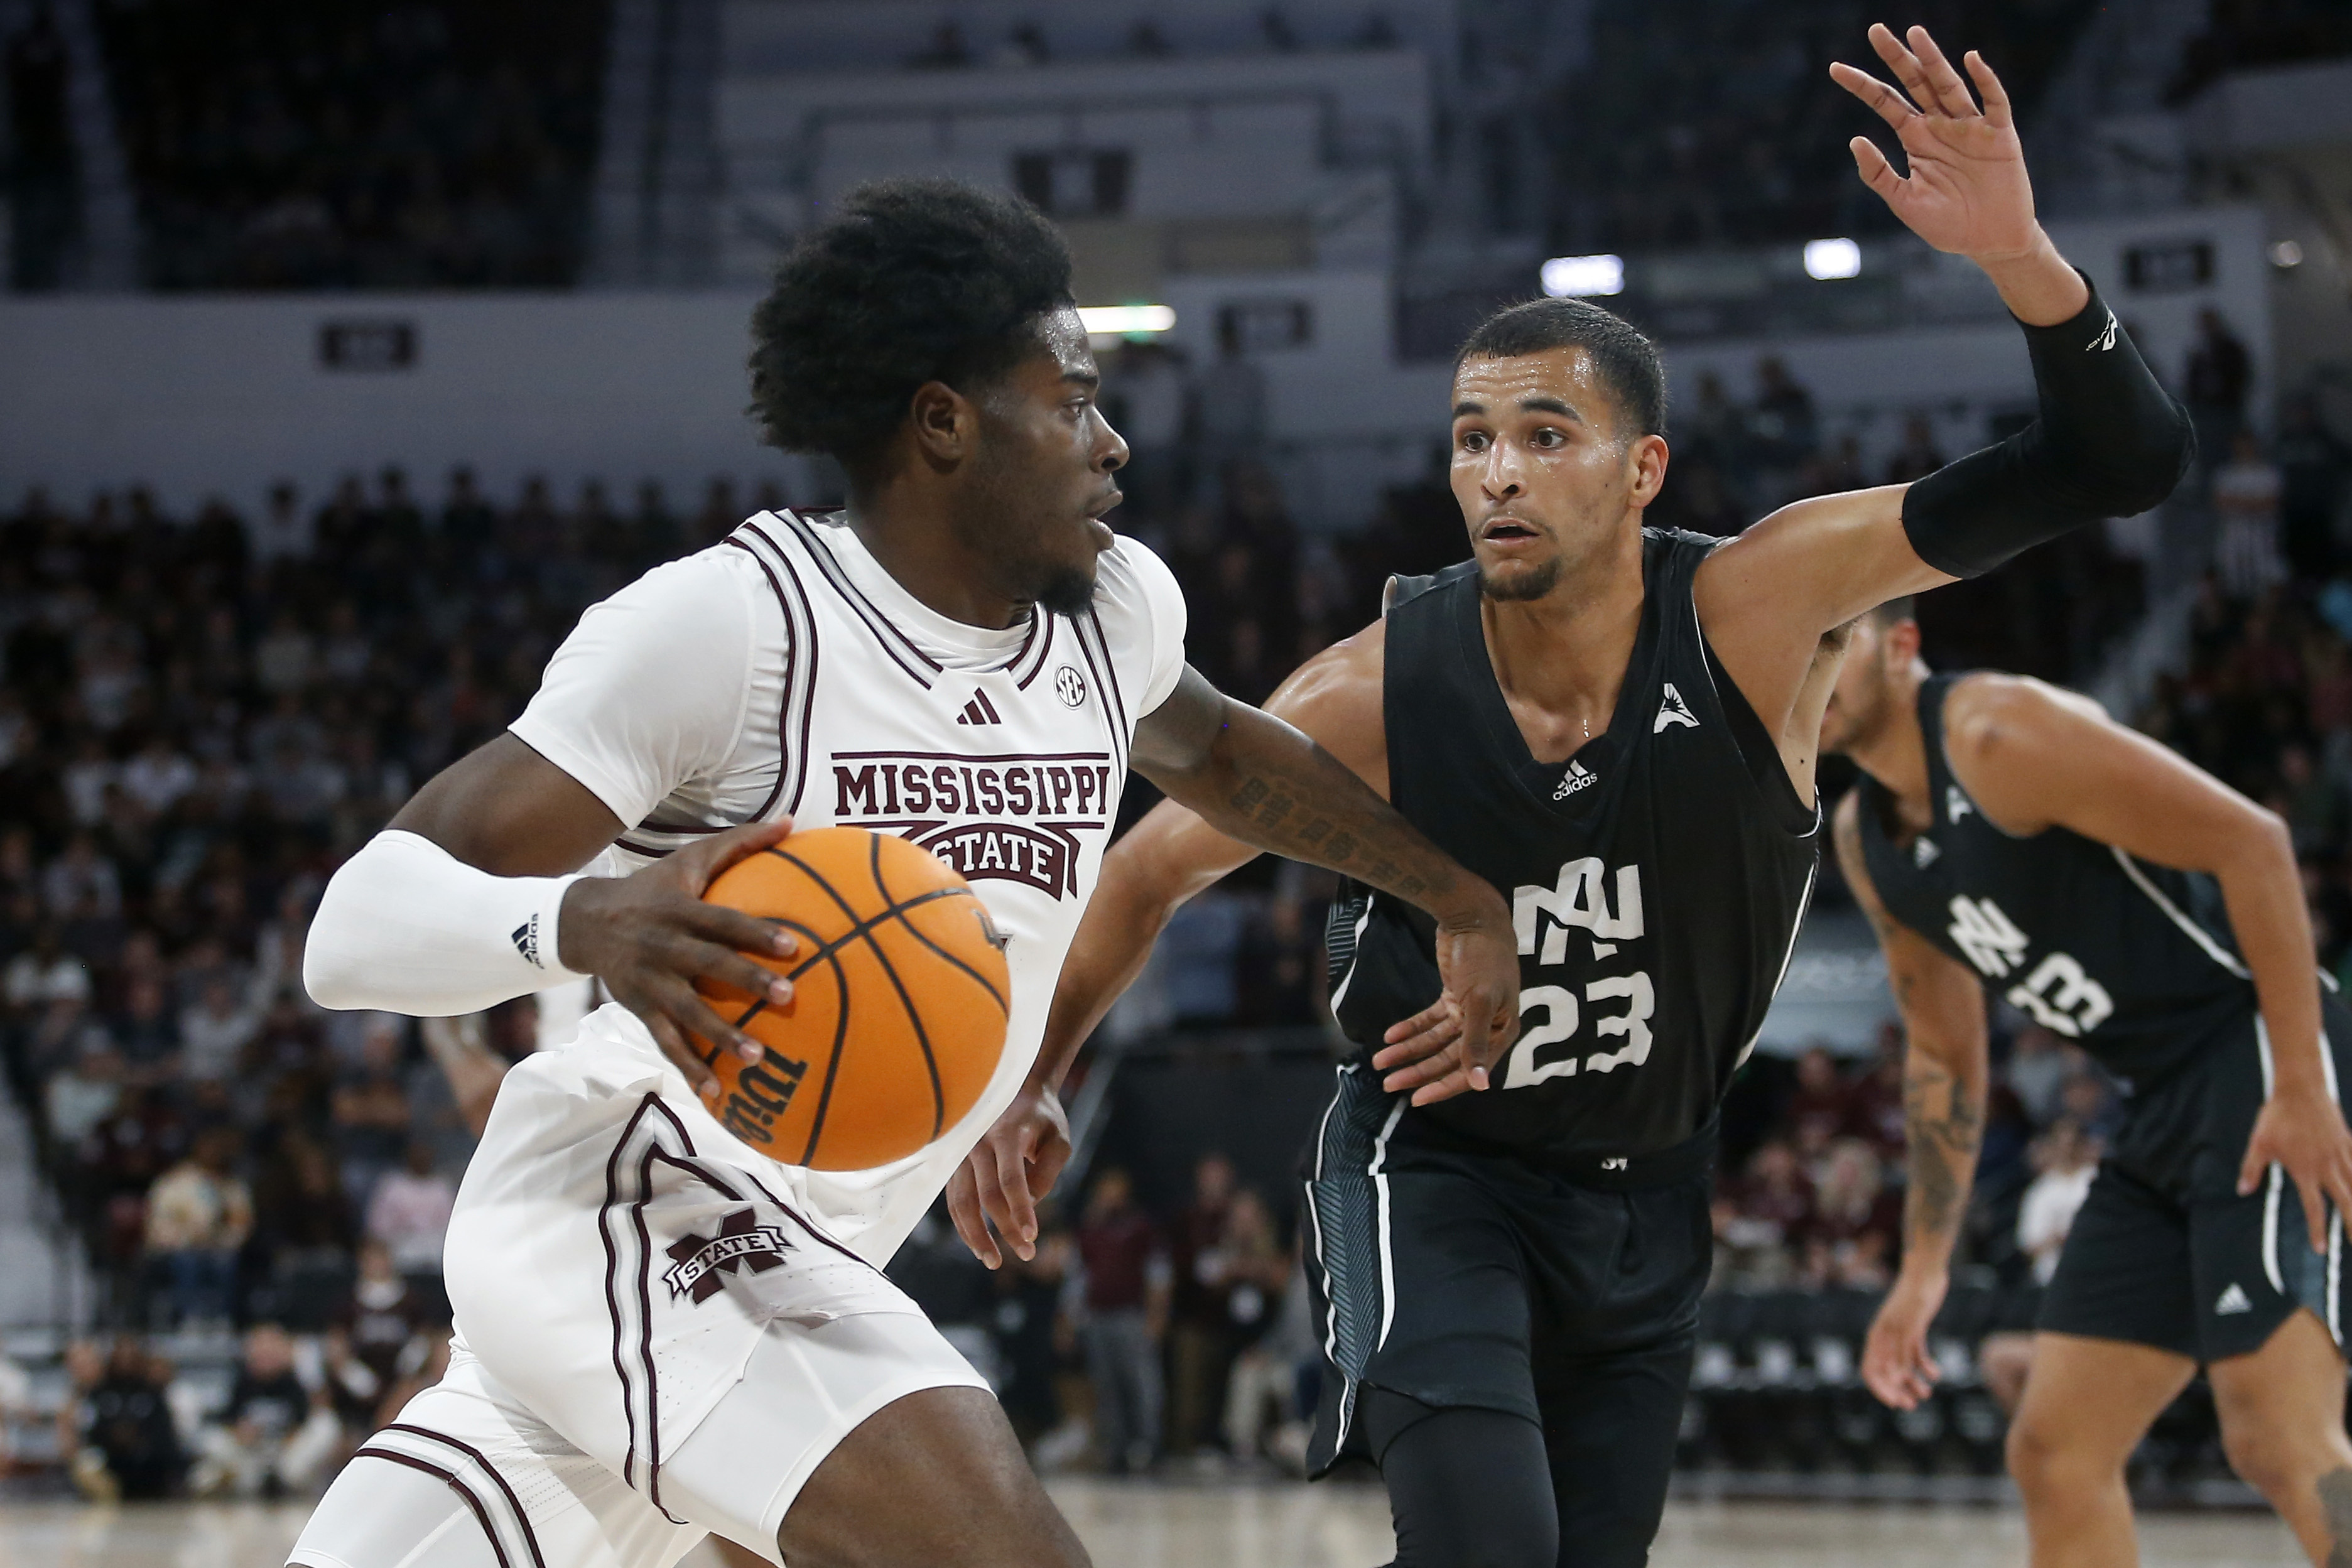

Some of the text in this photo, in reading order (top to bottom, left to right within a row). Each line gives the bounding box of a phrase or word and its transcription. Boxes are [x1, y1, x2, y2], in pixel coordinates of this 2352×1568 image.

[1056, 667, 1085, 706] SEC
[833, 764, 1110, 816] MISSISSIPPI
[1553, 773, 1598, 801] adidas
[931, 831, 1054, 885] STATE
[1503, 971, 1656, 1089] 23
[685, 1235, 766, 1280] STATE
